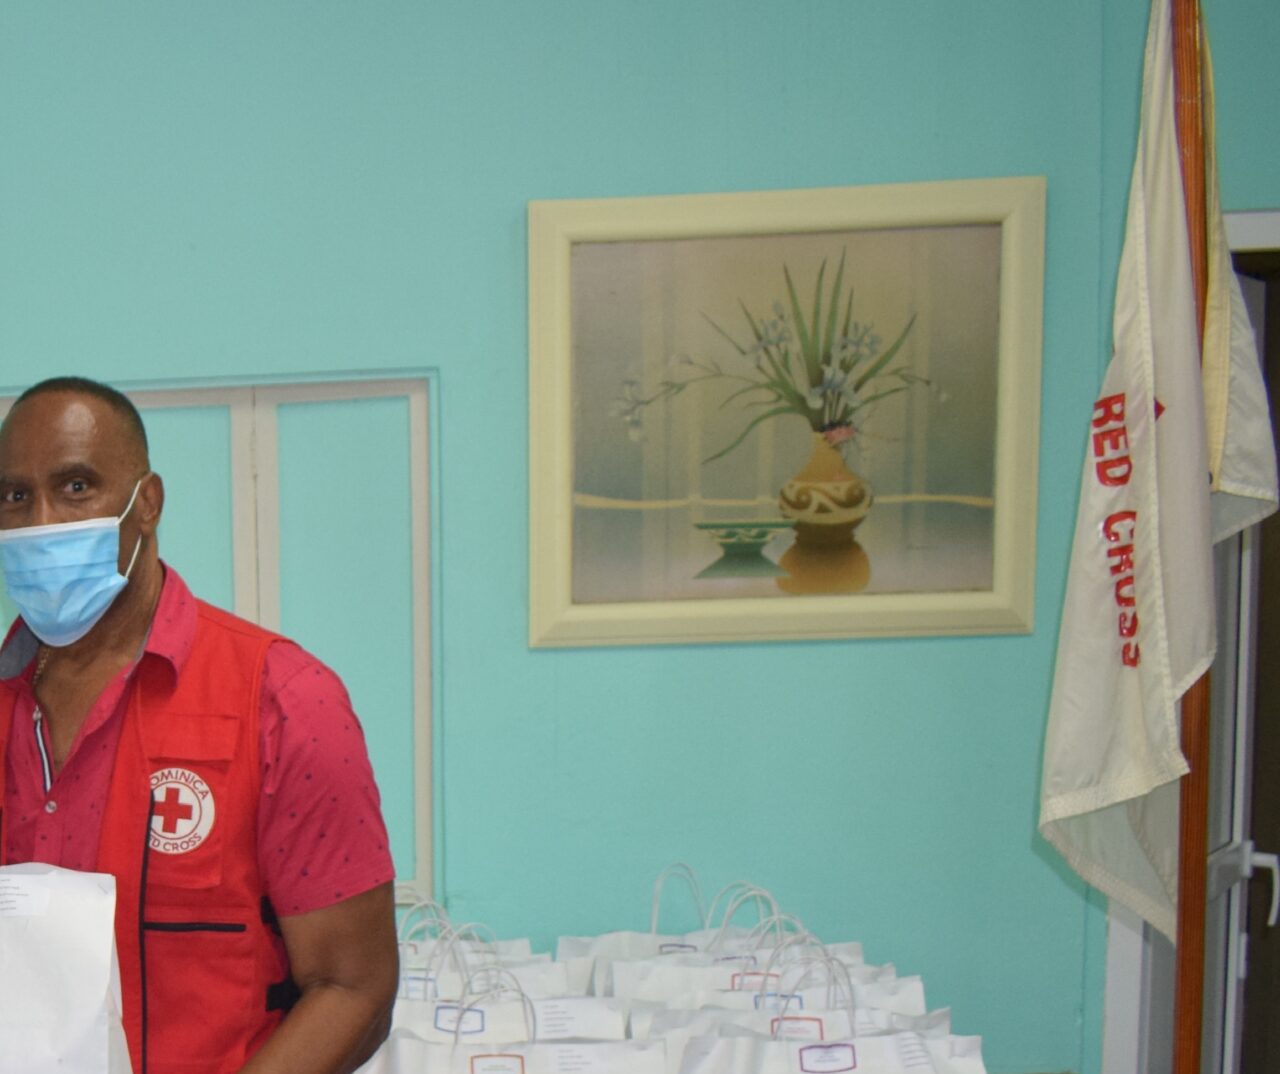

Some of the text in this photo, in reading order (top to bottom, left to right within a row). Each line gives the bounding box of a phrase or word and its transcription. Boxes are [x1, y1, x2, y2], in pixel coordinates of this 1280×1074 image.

[1091, 392, 1132, 487] RED
[150, 769, 210, 800] OMINICA
[162, 832, 202, 852] CROSS
